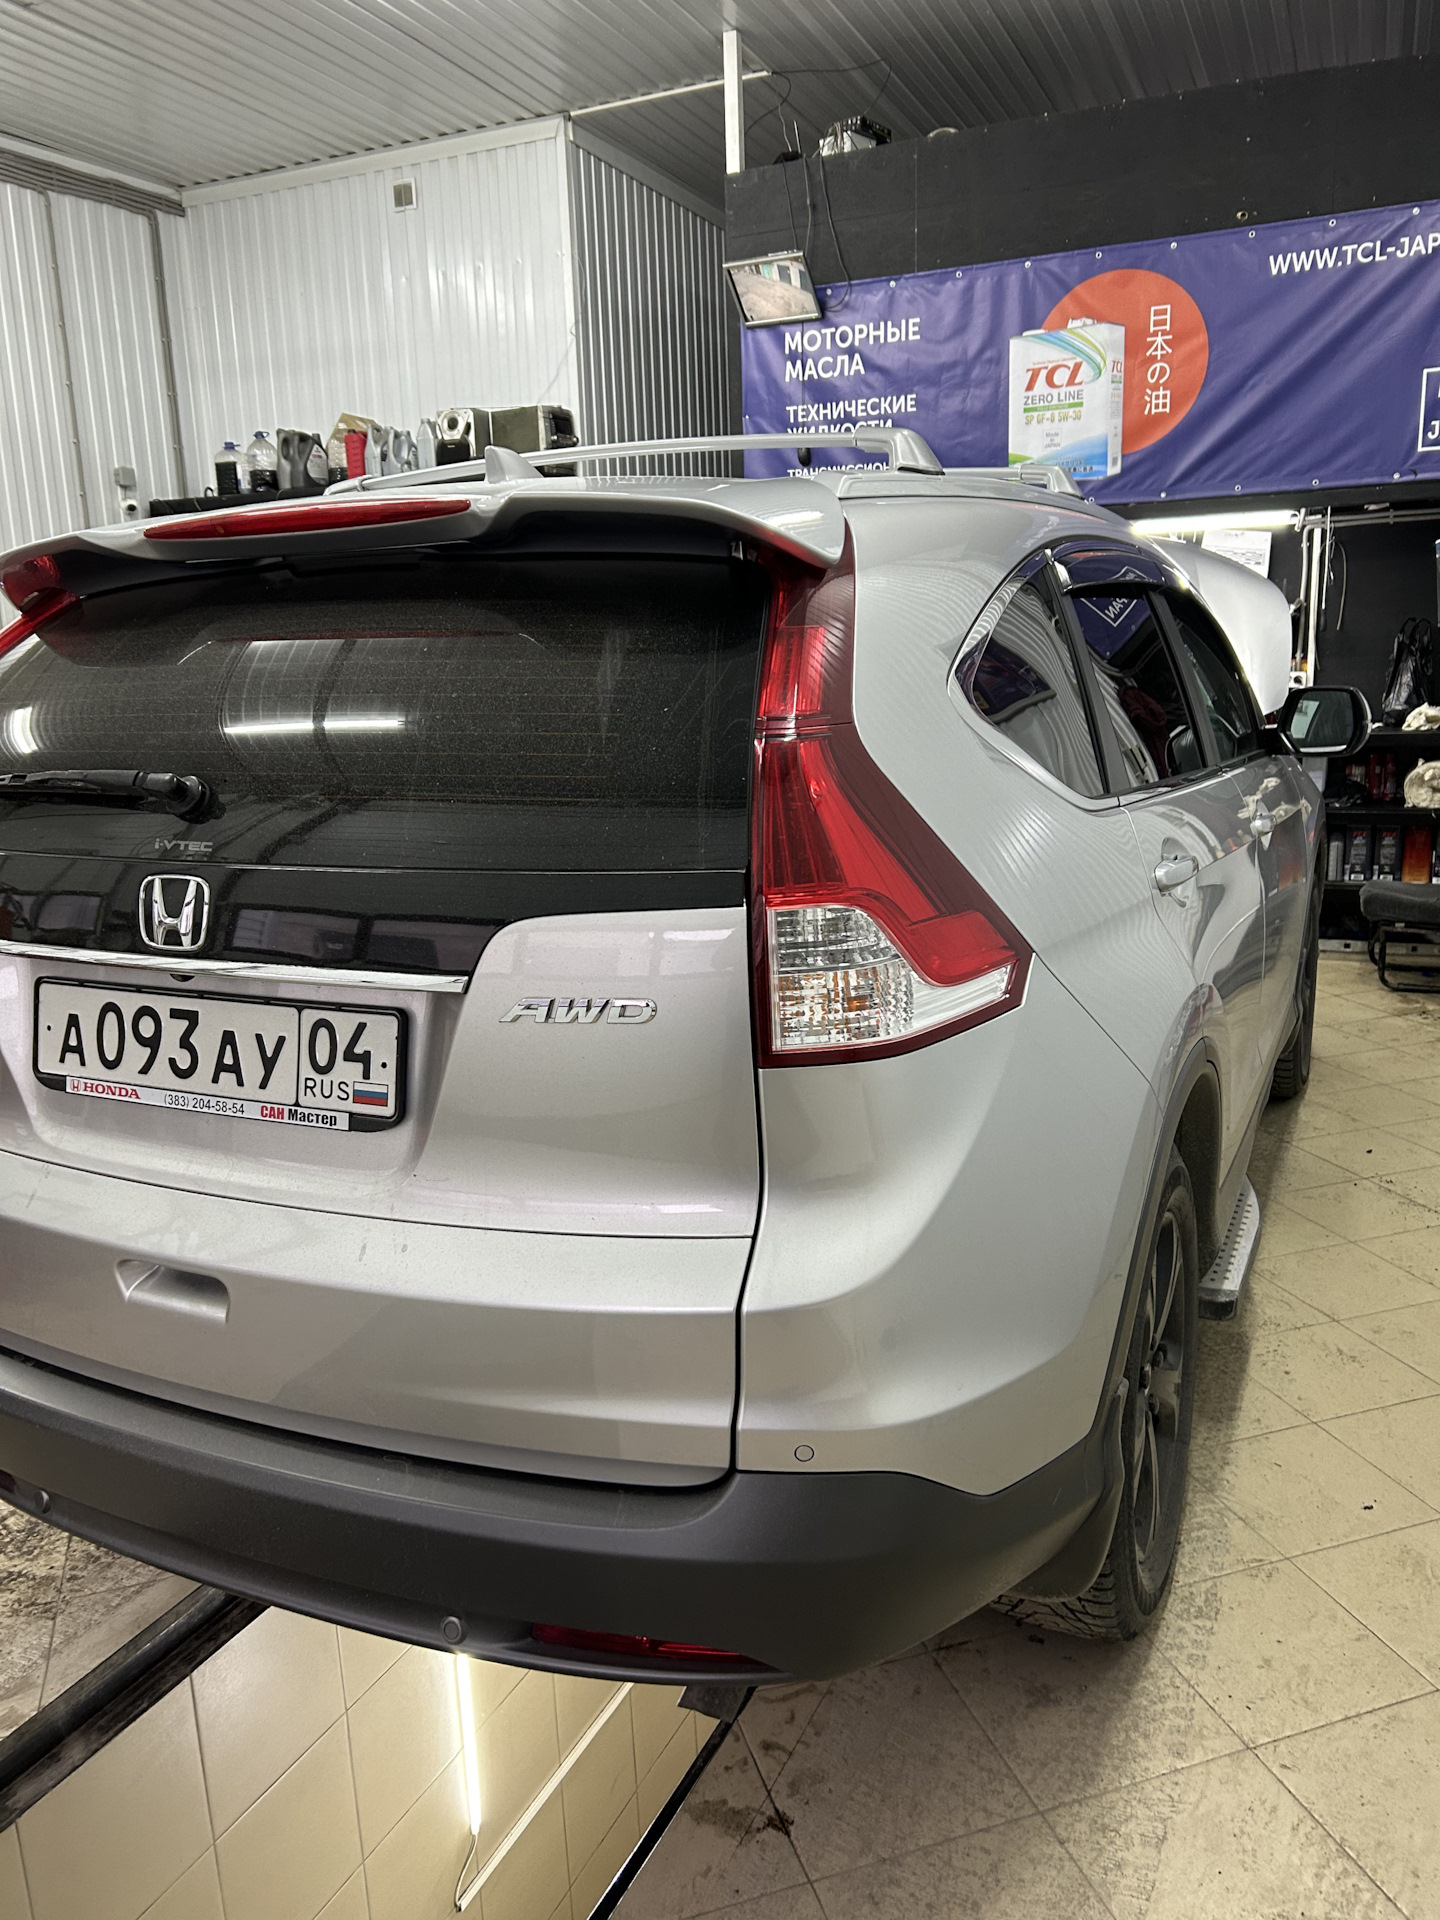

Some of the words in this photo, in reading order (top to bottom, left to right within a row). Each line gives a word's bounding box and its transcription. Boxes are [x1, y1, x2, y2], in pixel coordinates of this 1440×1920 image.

[784, 317, 921, 355] МОТОРНЫЕ
[784, 353, 866, 383] МАСЛА
[1144, 304, 1173, 415] 日本の油
[1025, 360, 1084, 392] TCL
[786, 394, 917, 423] ТЕХНИЧЕСКИЕ
[1023, 392, 1054, 406] ZERO
[1057, 389, 1084, 402] LINE
[1025, 414, 1034, 425] SP
[154, 838, 214, 852] i-VTEC
[498, 997, 658, 1025] AWD
[308, 1017, 372, 1081] 04
[304, 1077, 350, 1101] RUS
[83, 1081, 141, 1100] HONDA
[164, 1093, 190, 1108] (383)
[192, 1097, 245, 1116] 204-58-54
[260, 1104, 285, 1121] САН
[288, 1107, 338, 1127] Мастер
